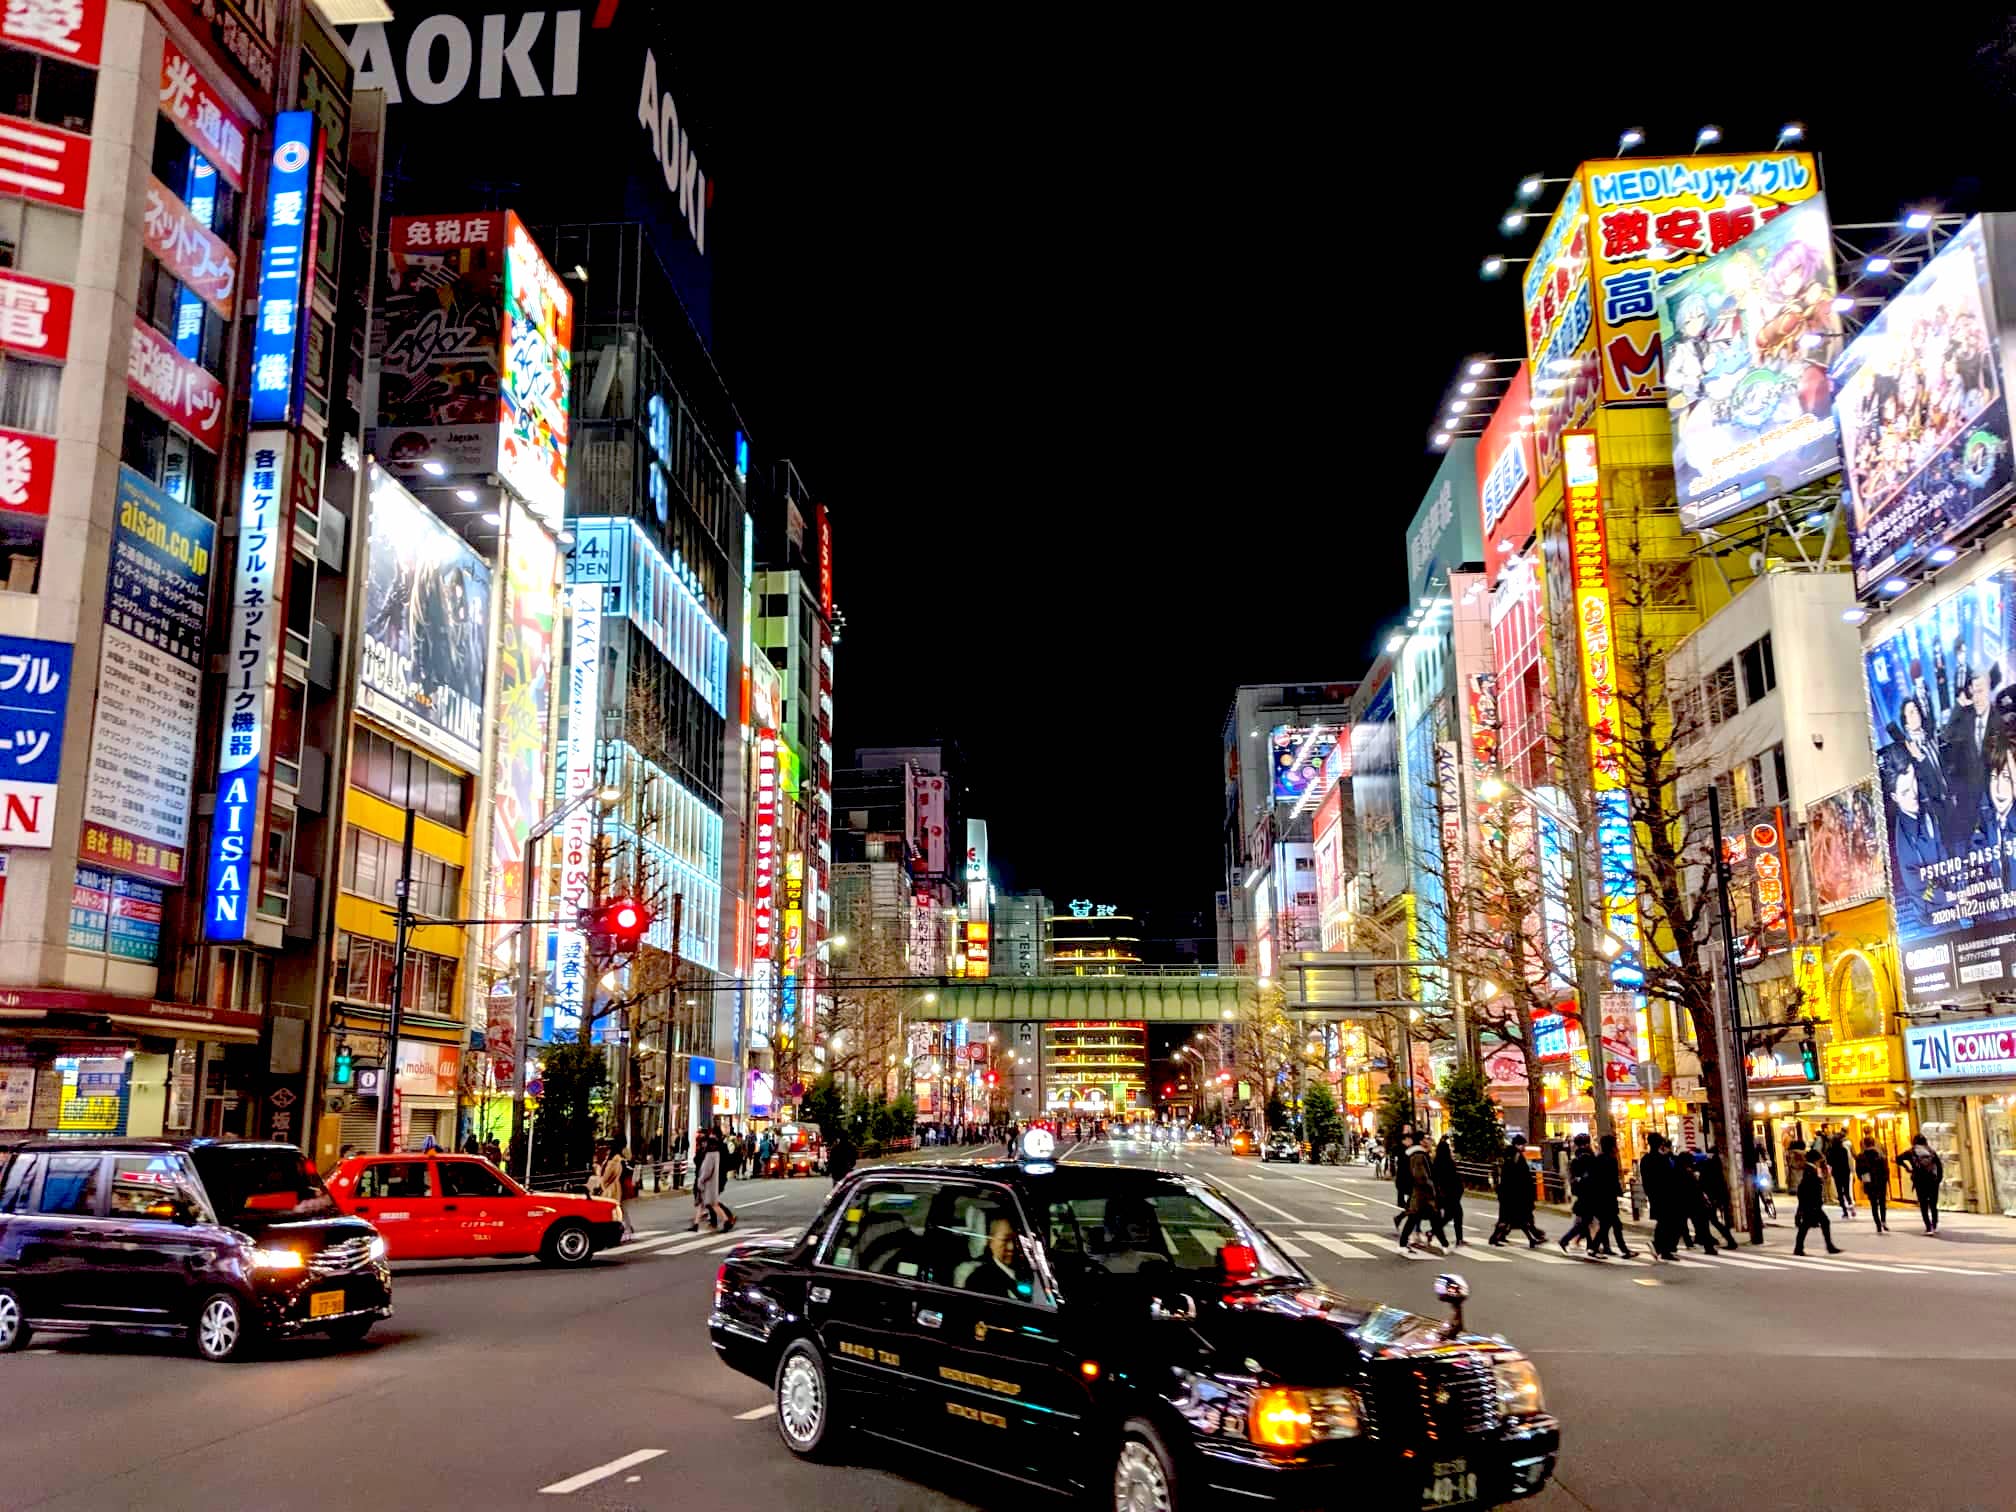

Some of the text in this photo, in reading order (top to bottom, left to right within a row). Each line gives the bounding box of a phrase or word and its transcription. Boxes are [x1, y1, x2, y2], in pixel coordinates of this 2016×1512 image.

[348, 10, 582, 105] AOKI
[638, 47, 706, 256] AOKI
[406, 218, 490, 246] 免税店
[252, 190, 303, 392] 愛三電機
[1483, 446, 1527, 534] SEGA
[120, 500, 209, 577] aisan.co.jp
[575, 598, 596, 673] AKKY
[1438, 744, 1455, 803] AKKY
[214, 777, 250, 921] AISAN
[567, 764, 592, 866] Tafree
[1919, 845, 2002, 882] PSYCHO-PASS
[406, 1060, 435, 1075] mobile
[1912, 1029, 2010, 1074] ZIN COMIC
